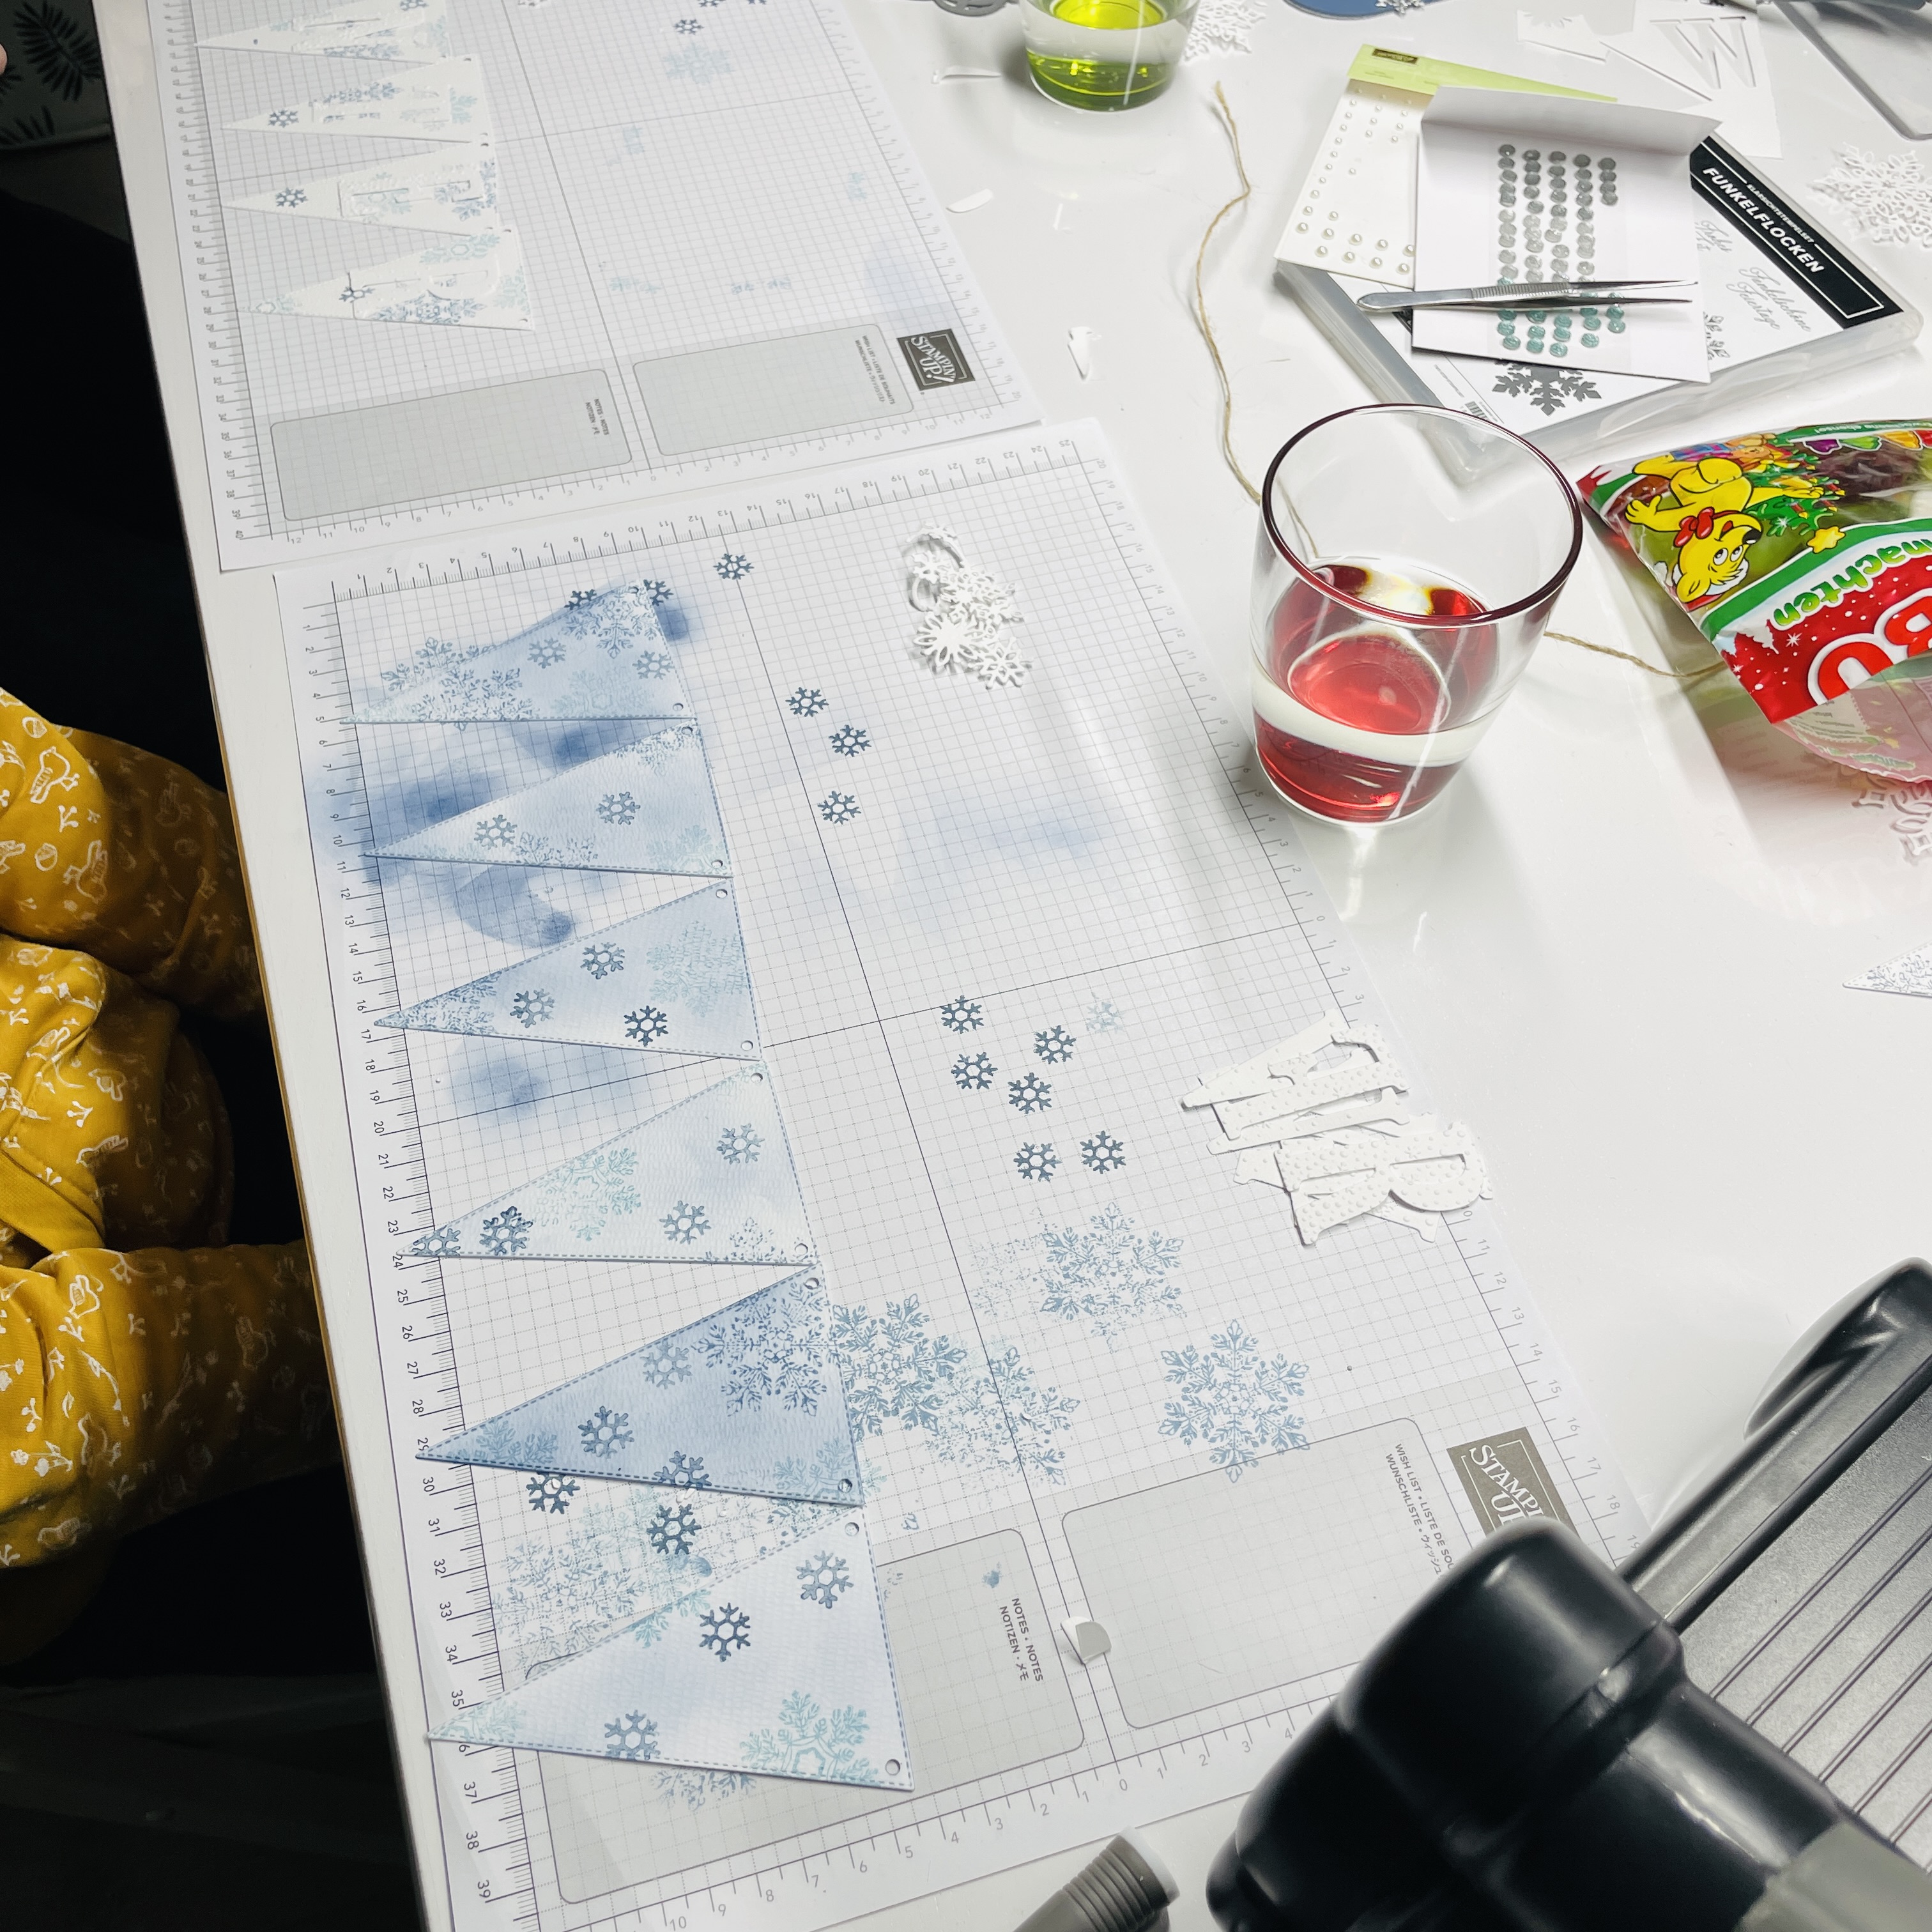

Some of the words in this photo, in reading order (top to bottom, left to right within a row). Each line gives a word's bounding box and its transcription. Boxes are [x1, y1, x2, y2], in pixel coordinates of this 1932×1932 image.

[1702, 167, 1825, 273] FUNKELFLOCKEN
[919, 356, 955, 383] UP!
[1773, 539, 1932, 626] nachten
[333, 834, 342, 845] 10
[337, 861, 346, 871] 11
[341, 888, 351, 898] 12
[344, 915, 355, 925] 13
[348, 943, 358, 954] 14
[352, 971, 363, 982] 15
[1096, 459, 1107, 469] 20
[1106, 480, 1116, 489] 19
[1116, 502, 1125, 510] 18
[1125, 523, 1135, 532] 17
[1135, 544, 1145, 553] 16
[1145, 565, 1154, 574] 15
[1155, 586, 1165, 595] 14
[1165, 607, 1175, 616] 13
[1176, 629, 1186, 638] 12
[1186, 650, 1197, 660] 11
[1197, 672, 1208, 682] 10
[1478, 1238, 1490, 1250] 11
[1494, 1271, 1506, 1284] 12
[1512, 1307, 1524, 1320] 13
[1529, 1342, 1543, 1356] 14
[1548, 1379, 1562, 1393] 15
[1567, 1417, 1581, 1432] 16
[1587, 1457, 1602, 1471] 17
[1606, 1494, 1620, 1510] 18
[356, 1000, 367, 1011] 16
[360, 1029, 371, 1039] 17
[365, 1059, 376, 1071] 18
[369, 1090, 380, 1101] 19
[374, 1121, 385, 1133] 20
[378, 1153, 389, 1165] 21
[383, 1186, 394, 1200] 22
[387, 1220, 399, 1233] 23
[392, 1255, 404, 1268] 24
[397, 1289, 408, 1303] 25
[402, 1325, 413, 1340] 26
[407, 1361, 418, 1374] 27
[412, 1399, 424, 1414] 28
[422, 1477, 435, 1492] 30
[1469, 1445, 1544, 1519] STAMPI
[1395, 1443, 1411, 1469] WISH
[1407, 1471, 1422, 1492] LIST
[1420, 1501, 1438, 1530] LISTE
[1433, 1532, 1446, 1546] DE
[1386, 1453, 1422, 1526] WUNSCHLISTE
[1420, 1535, 1442, 1575] ウィッシュ
[428, 1518, 440, 1533] 31
[434, 1558, 447, 1575] 32
[440, 1601, 452, 1618] 33
[999, 1606, 1021, 1653] NOTIZEN
[1016, 1662, 1029, 1682] メモ
[1011, 1598, 1029, 1634] NOTES
[1025, 1644, 1043, 1682] NOTES
[445, 1645, 458, 1662] 34
[451, 1689, 464, 1706] 35
[459, 1742, 470, 1752] 6
[464, 1781, 477, 1798] 37
[670, 1916, 687, 1931] 10
[718, 1903, 726, 1917] 9
[765, 1889, 774, 1902] 8
[811, 1874, 819, 1888] 7
[859, 1860, 868, 1873] 6
[905, 1845, 914, 1859] 5
[951, 1831, 959, 1844] 4
[995, 1818, 1004, 1830] 3
[1040, 1803, 1050, 1816] 2
[1082, 1790, 1089, 1803] 1
[1119, 1779, 1128, 1791] 0
[1157, 1767, 1164, 1779] 1
[1199, 1754, 1209, 1767] 2
[1241, 1740, 1251, 1753] 3
[1284, 1728, 1293, 1740] 4
[466, 1830, 479, 1850] 38
[477, 1880, 491, 1898] 39
